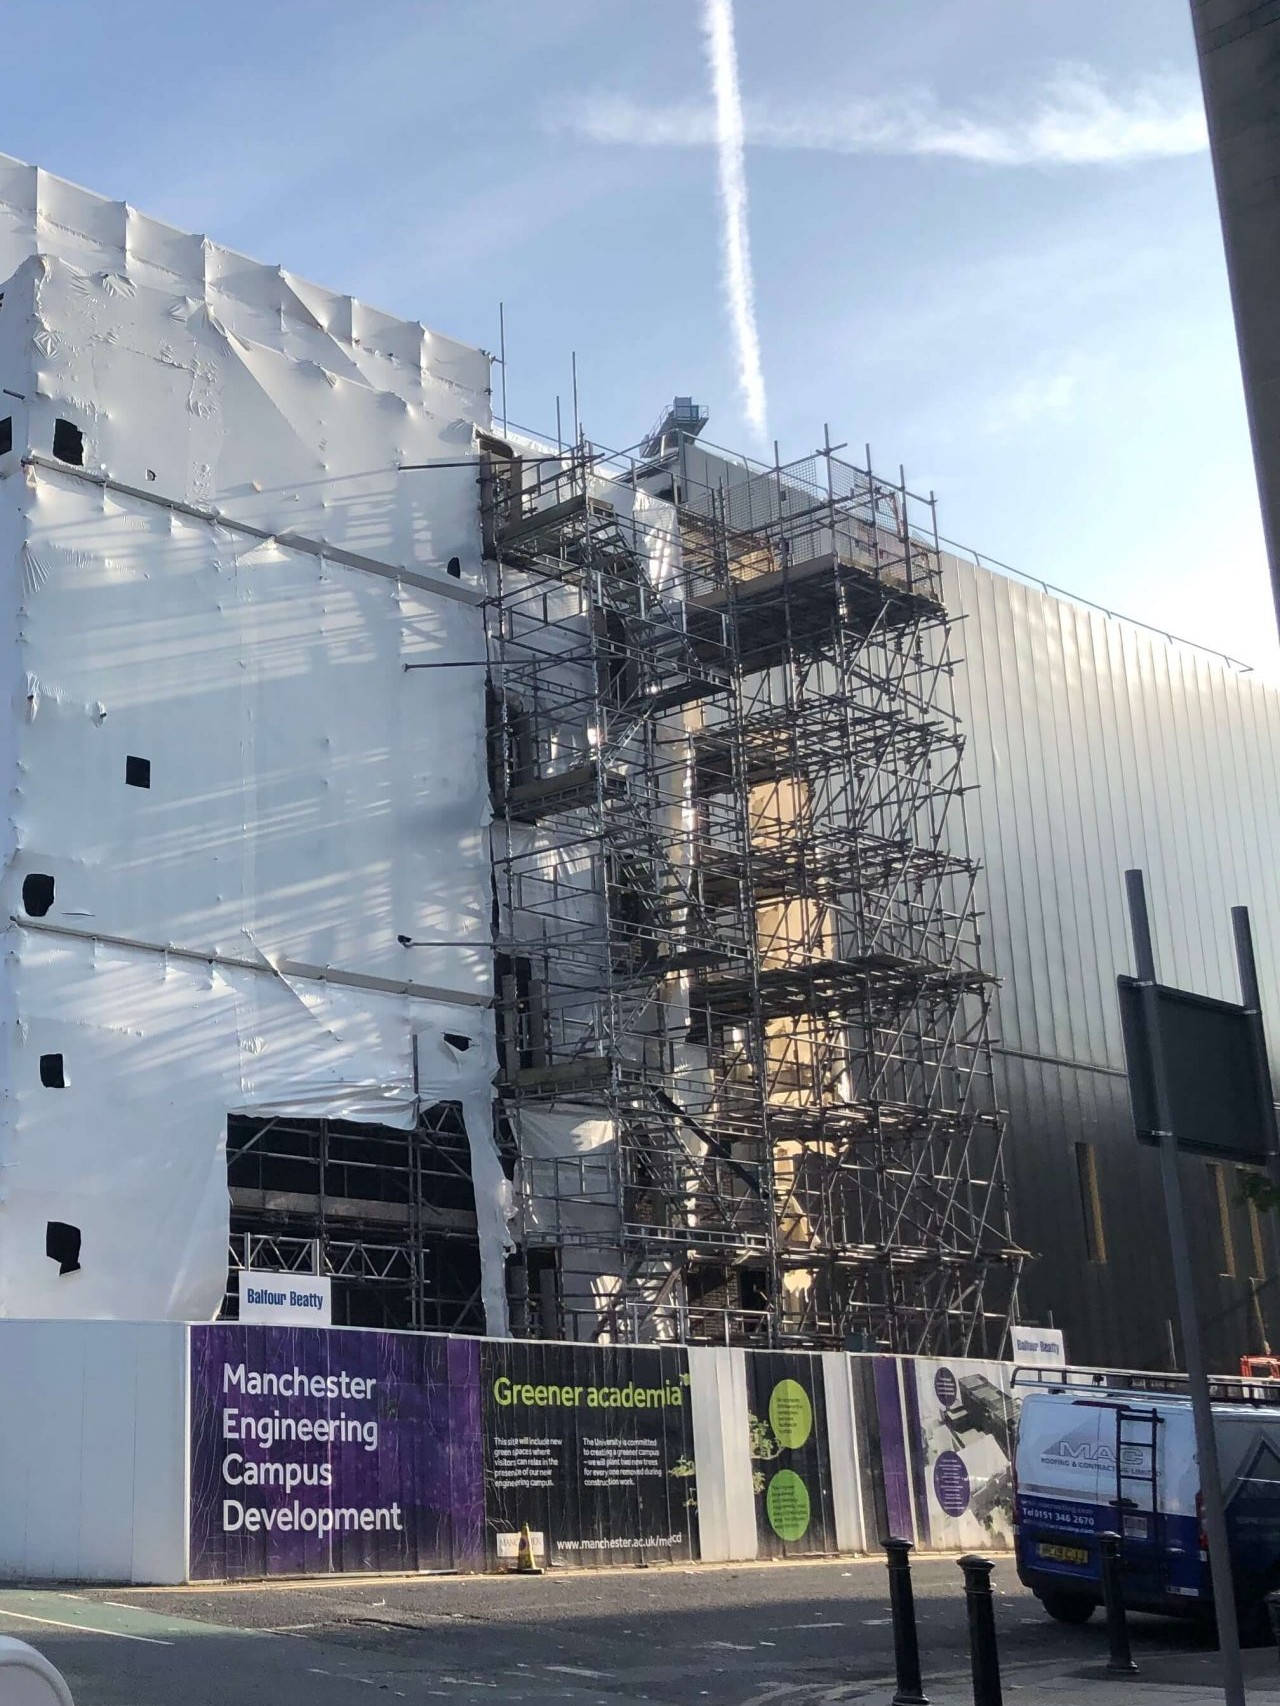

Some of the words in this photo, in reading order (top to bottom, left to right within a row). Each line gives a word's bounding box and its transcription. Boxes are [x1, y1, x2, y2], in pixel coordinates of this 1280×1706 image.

[247, 1288, 287, 1306] Balfour
[289, 1290, 323, 1310] Beatty
[223, 1363, 376, 1399] Manchester
[493, 1377, 583, 1406] Greener
[586, 1379, 682, 1408] academia
[223, 1408, 378, 1451] Engineering
[494, 1437, 507, 1446] This
[507, 1437, 518, 1446] site
[519, 1437, 529, 1445] will
[529, 1438, 549, 1446] include
[583, 1437, 594, 1446] The
[594, 1438, 621, 1447] University
[622, 1438, 627, 1446] is
[627, 1438, 657, 1446] committed
[494, 1449, 511, 1457] green
[512, 1448, 532, 1457] spaces
[532, 1448, 551, 1456] where
[583, 1448, 590, 1456] to
[590, 1448, 612, 1457] creating
[617, 1449, 638, 1457] greener
[638, 1449, 660, 1457] campus
[1059, 1441, 1144, 1466] MAC
[494, 1458, 516, 1466] visitors
[528, 1458, 542, 1466] relax
[542, 1458, 548, 1466] in
[548, 1458, 559, 1466] the
[596, 1458, 606, 1466] will
[607, 1458, 620, 1468] plant
[620, 1458, 631, 1466] two
[643, 1458, 658, 1466] trees
[1041, 1457, 1070, 1468] ROOFING
[1078, 1462, 1130, 1474] CONTRACTNG
[222, 1453, 333, 1493] Campus
[494, 1469, 521, 1478] presence
[522, 1467, 529, 1476] of
[584, 1467, 592, 1476] for
[593, 1469, 608, 1478] every
[620, 1468, 644, 1476] removed
[644, 1468, 662, 1477] during
[495, 1479, 530, 1489] engineering
[530, 1479, 554, 1488] campus.
[584, 1478, 619, 1486] construction
[620, 1478, 635, 1486] work.
[223, 1500, 403, 1539] Development
[1022, 1507, 1034, 1516] Tel
[1034, 1509, 1052, 1520] 0151
[1055, 1512, 1071, 1522] 346
[1073, 1515, 1095, 1526] 2670
[557, 1532, 682, 1550] www.manchester.ac.uk/mecd
